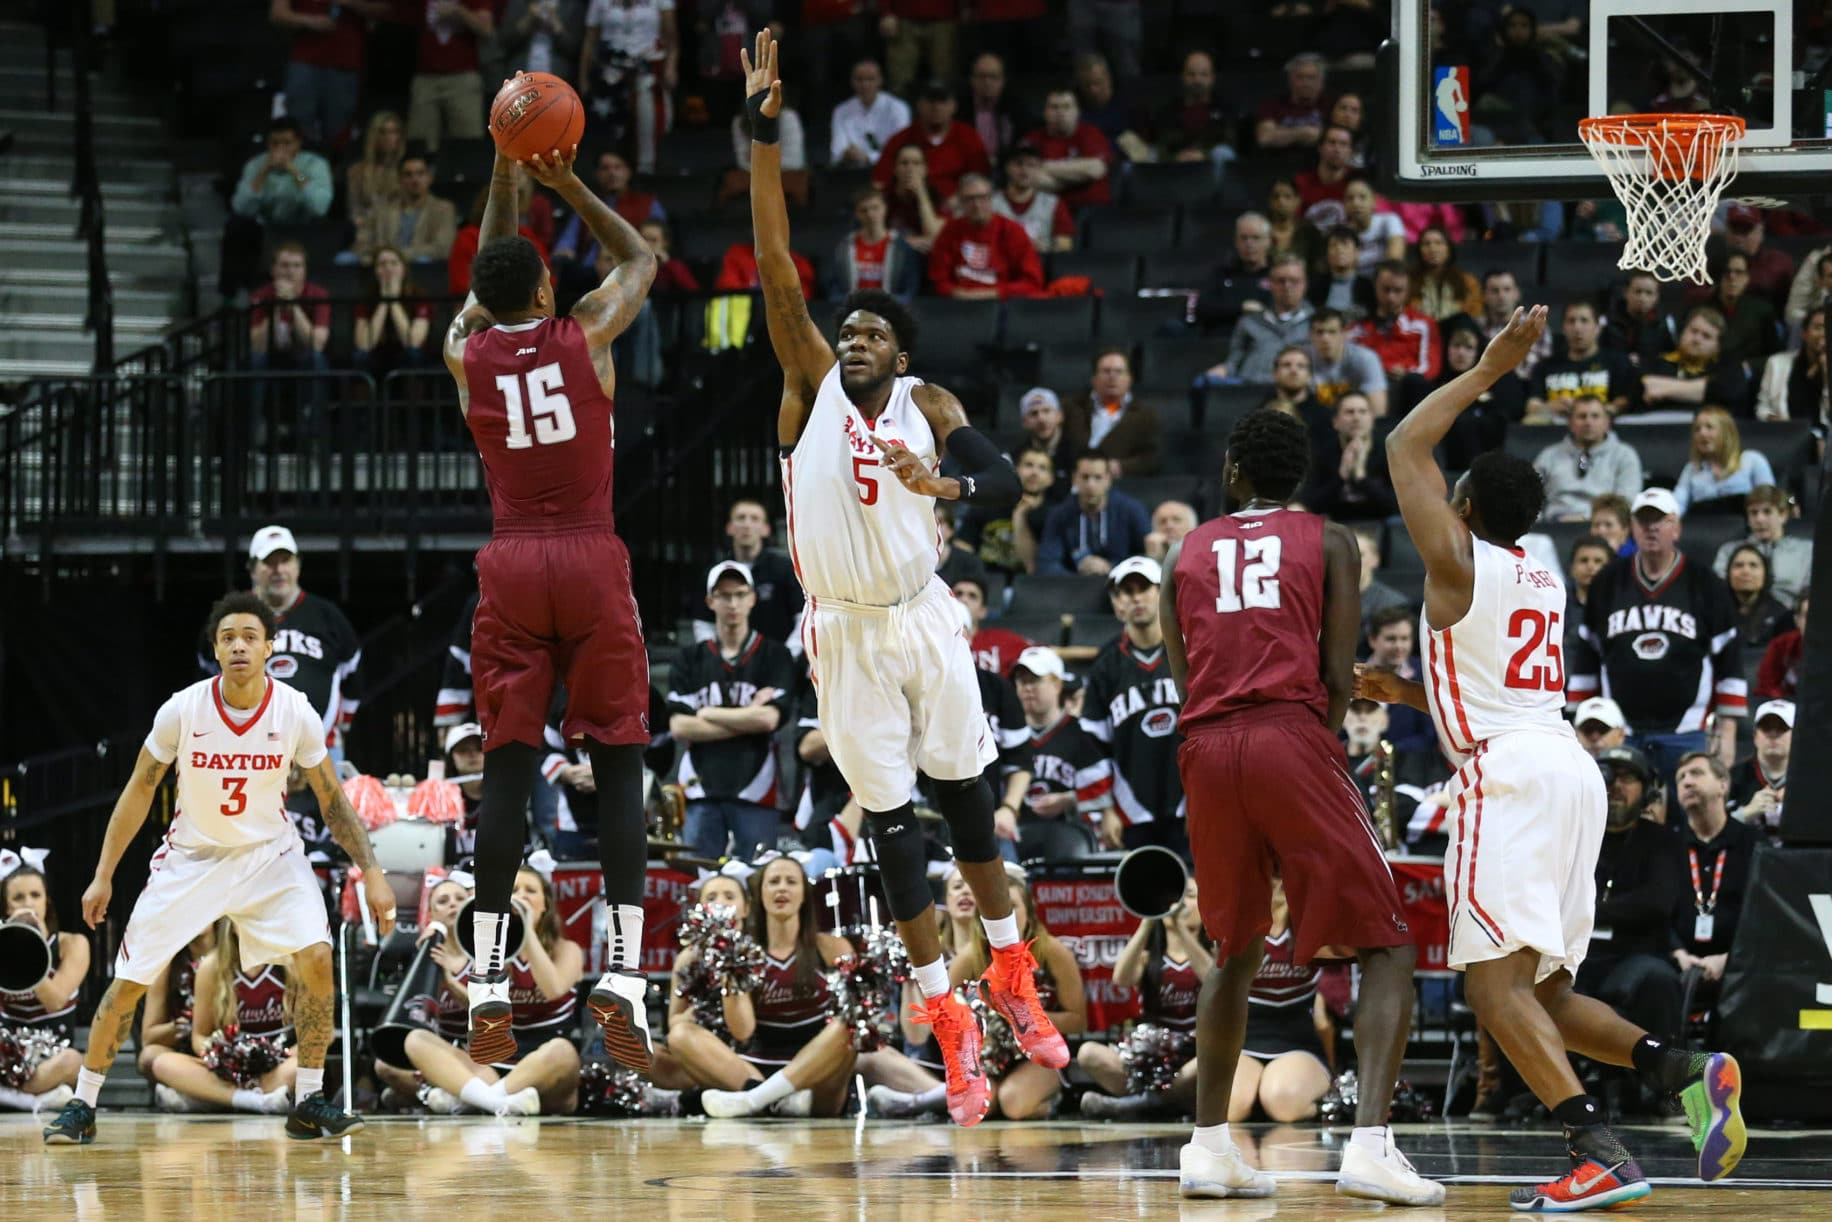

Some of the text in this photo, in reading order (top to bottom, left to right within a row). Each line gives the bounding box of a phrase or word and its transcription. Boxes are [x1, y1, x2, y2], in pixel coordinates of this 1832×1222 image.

[1438, 129, 1458, 140] NBA
[1420, 164, 1477, 177] SPALDING
[495, 361, 577, 450] 15
[852, 456, 879, 506] 5
[1211, 535, 1282, 613] 12
[1606, 605, 1697, 639] HAWKS
[272, 629, 323, 659] WKS
[1504, 608, 1564, 692] 25
[191, 752, 284, 770] DAYTON
[1033, 755, 1076, 788] WKS
[220, 777, 248, 816] 3
